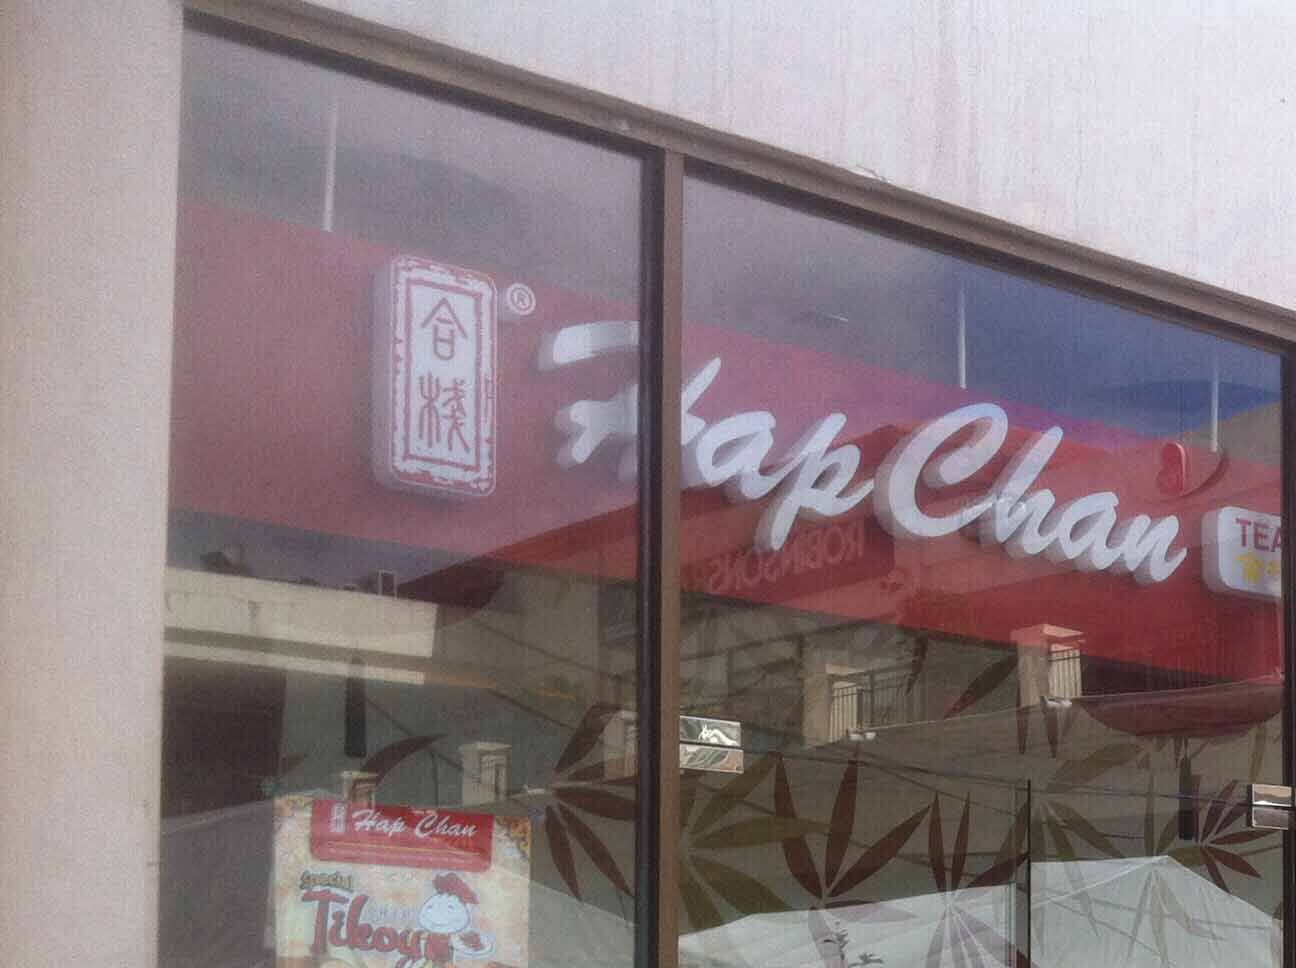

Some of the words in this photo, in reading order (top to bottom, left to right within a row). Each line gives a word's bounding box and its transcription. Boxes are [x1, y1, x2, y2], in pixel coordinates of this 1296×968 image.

[880, 402, 1188, 583] Chan
[351, 807, 407, 838] Hap
[412, 810, 478, 839] Chan
